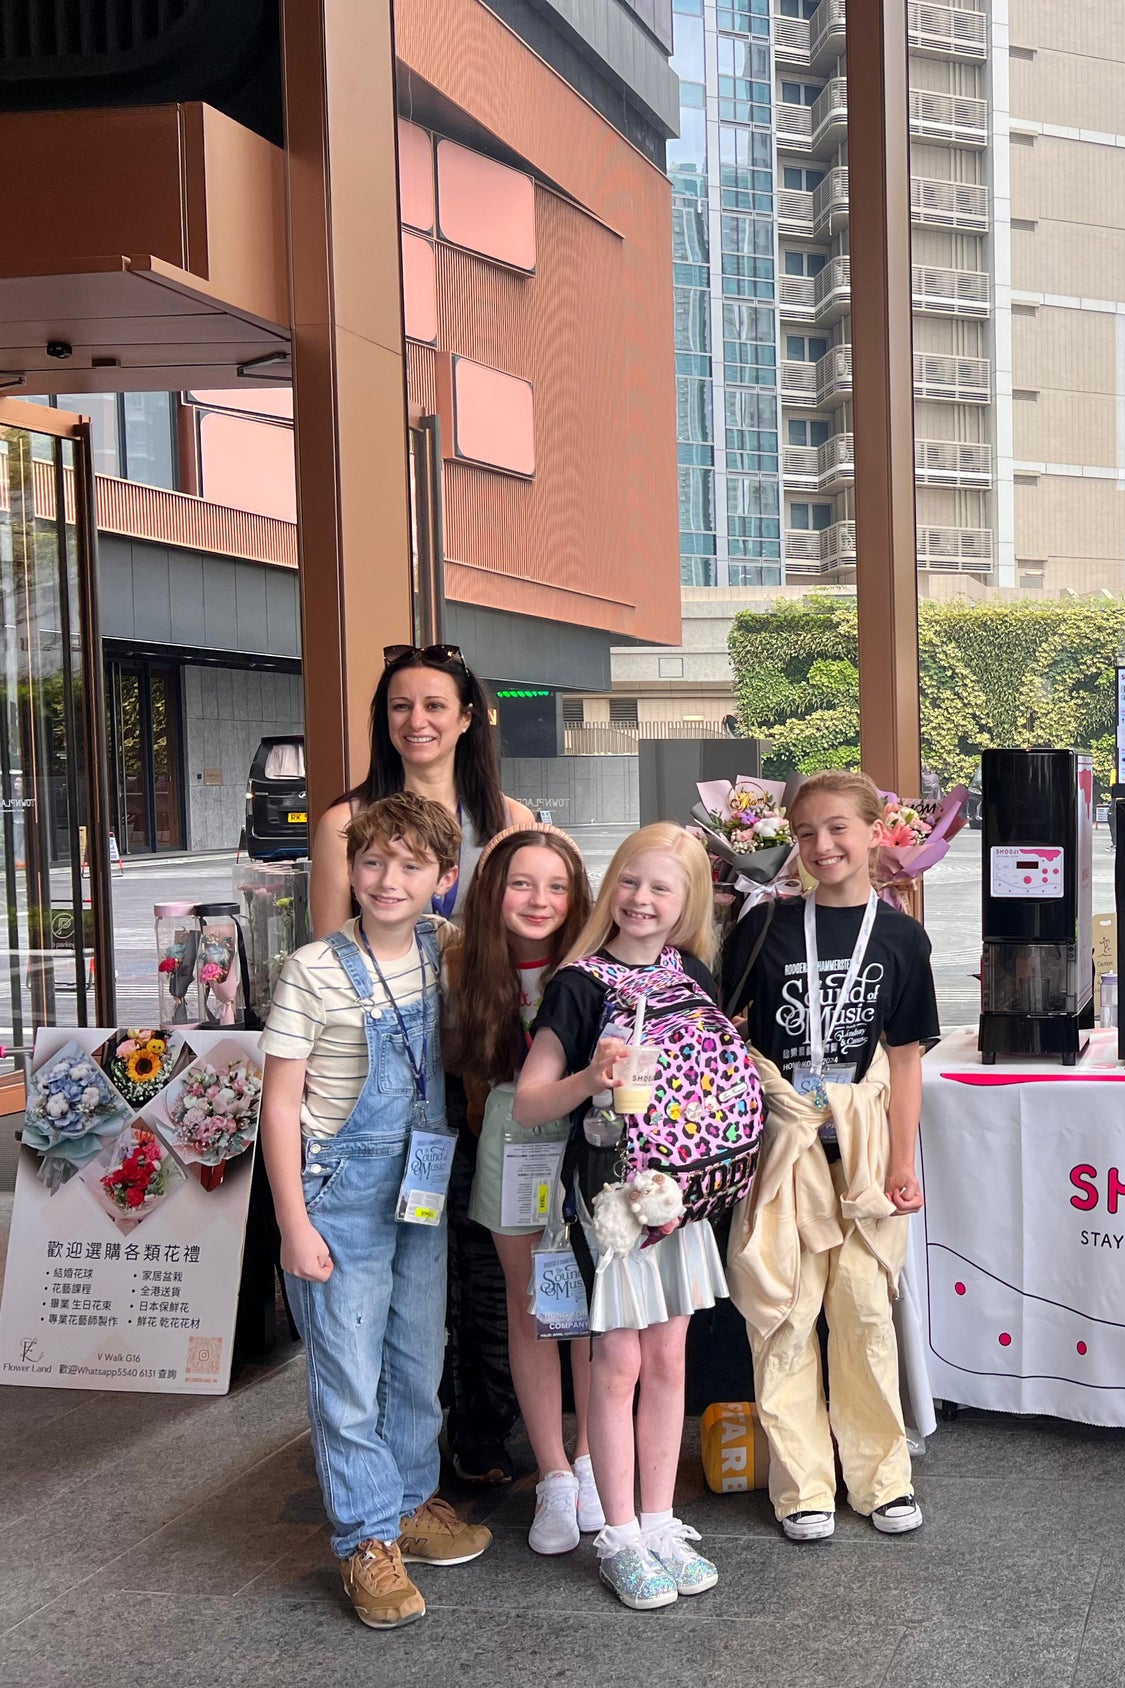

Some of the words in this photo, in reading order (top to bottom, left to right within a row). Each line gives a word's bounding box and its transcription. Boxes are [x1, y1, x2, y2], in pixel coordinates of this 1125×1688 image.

[784, 962, 808, 976] RODGER
[867, 984, 880, 1001] of
[1081, 1230, 1124, 1250] STAY
[47, 1240, 201, 1263] 歡迎選購各類花禮
[53, 1267, 94, 1280] 結婚花球
[142, 1270, 183, 1283] 家居盆栽
[52, 1283, 92, 1295] 花藝課程
[140, 1285, 181, 1298] 全港送貨
[72, 1299, 112, 1311] 生日花束
[139, 1300, 190, 1313] 日本保鮮花
[48, 1313, 119, 1327] 專業花藝師製作
[136, 1316, 158, 1328] 鮮花
[159, 1317, 200, 1330] 乾花花材
[549, 1320, 590, 1330] COMPANY
[103, 1352, 124, 1362] Walk
[125, 1354, 141, 1363] G16
[3, 1363, 30, 1373] Flower
[31, 1365, 52, 1374] Land
[139, 1368, 156, 1378] 6131
[158, 1369, 177, 1380] 查詢
